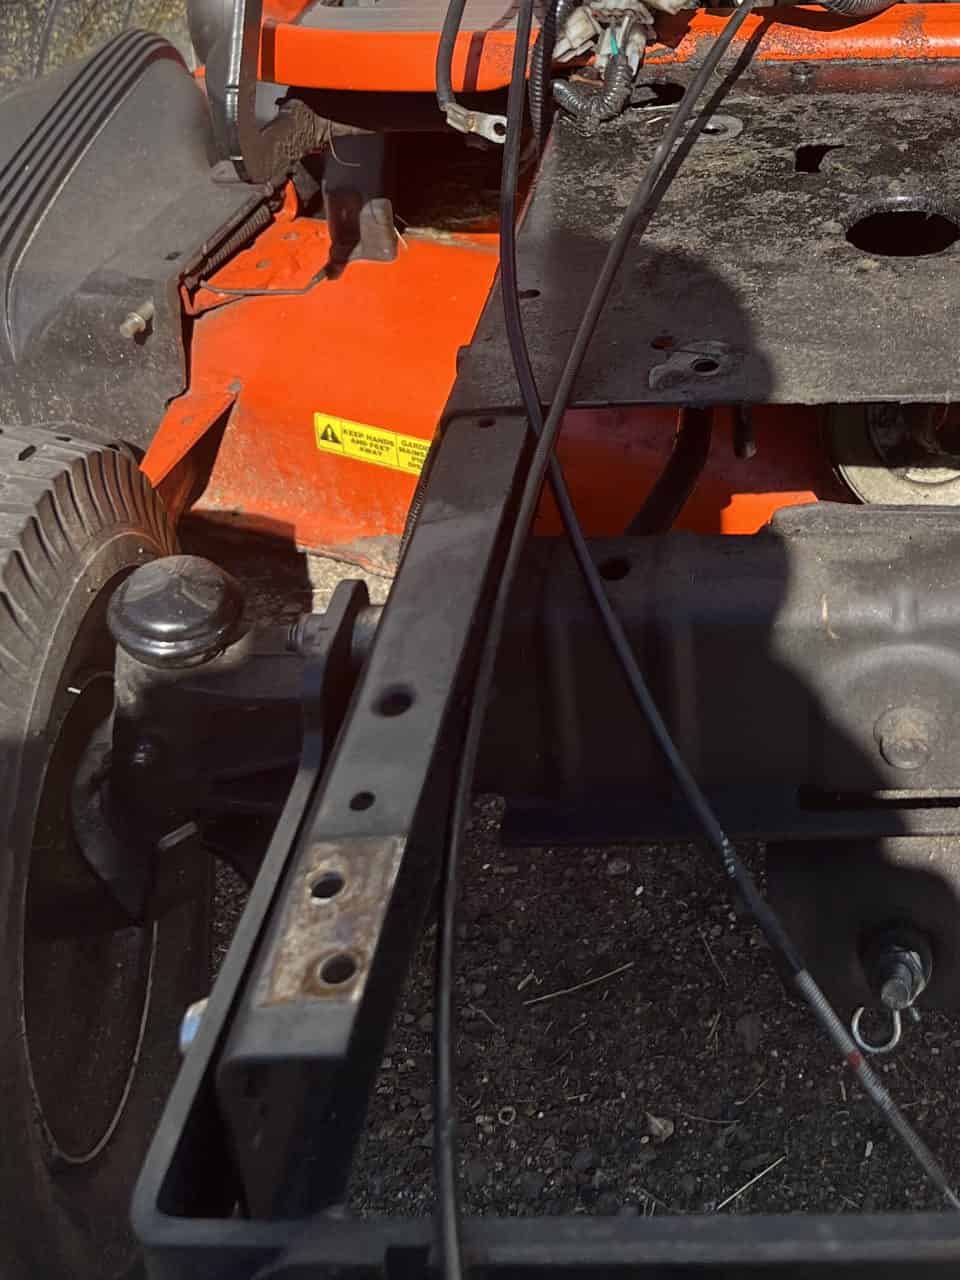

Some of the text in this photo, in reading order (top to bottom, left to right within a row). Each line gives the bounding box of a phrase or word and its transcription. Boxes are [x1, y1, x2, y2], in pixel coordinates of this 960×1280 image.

[343, 429, 394, 447] KEEP HANDS
[351, 438, 390, 451] AND FEET
